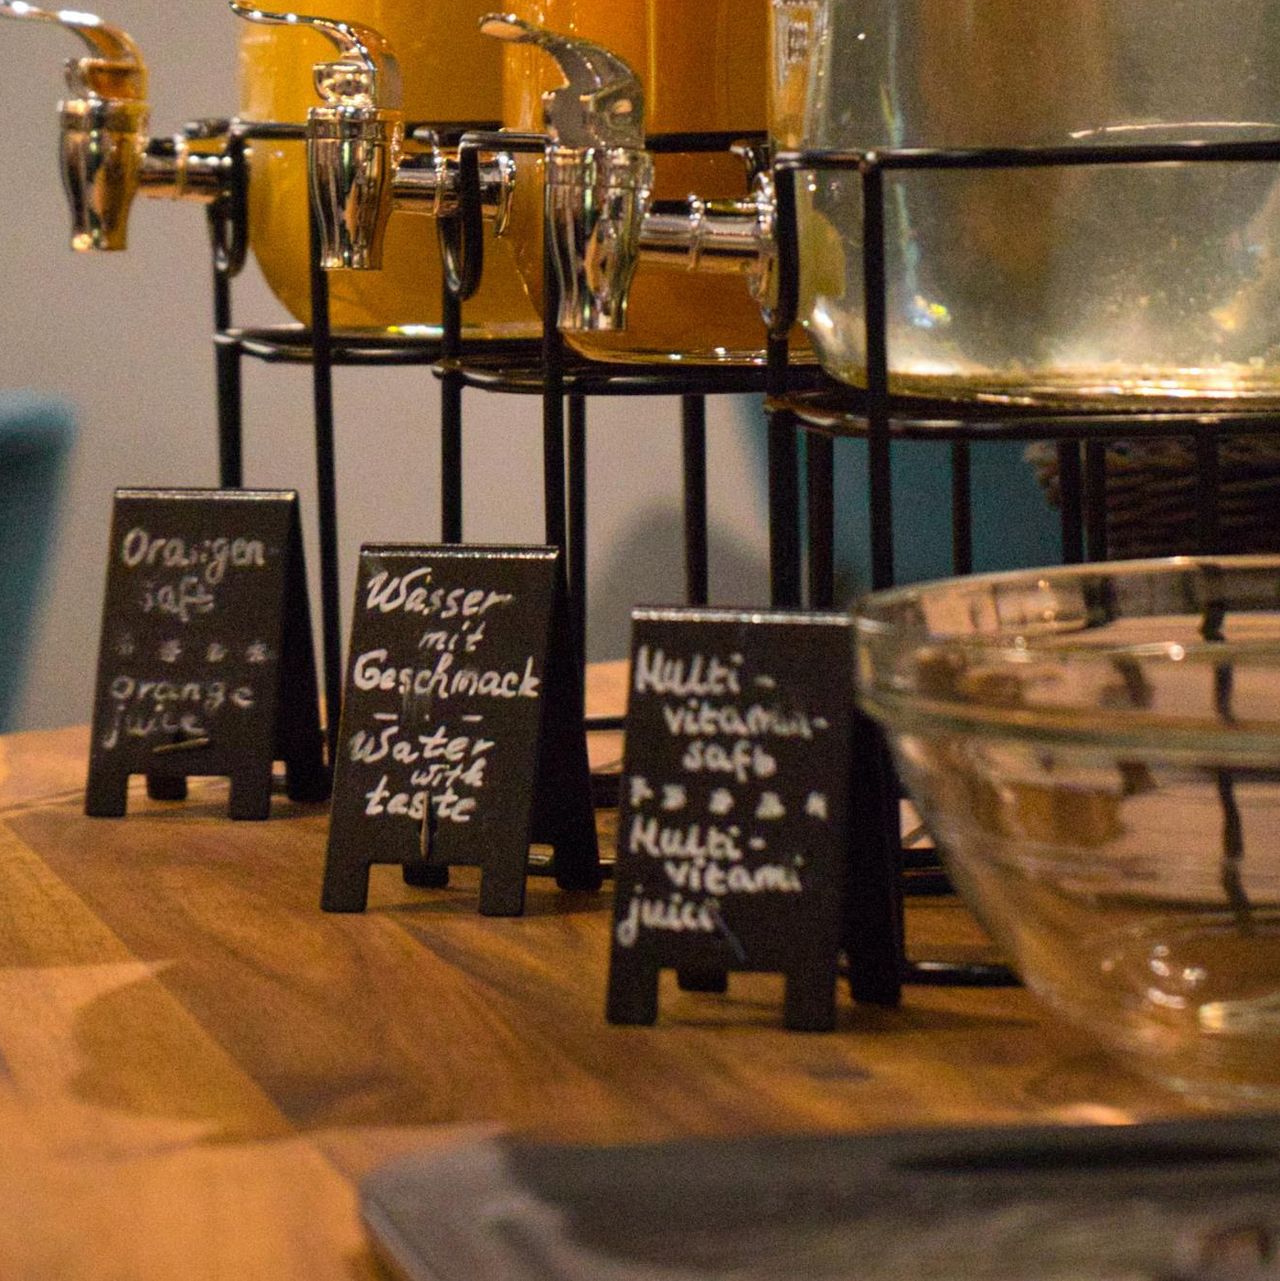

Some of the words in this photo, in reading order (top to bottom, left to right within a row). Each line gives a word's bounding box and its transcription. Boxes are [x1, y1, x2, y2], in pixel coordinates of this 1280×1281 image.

[366, 566, 513, 619] Wasser
[418, 620, 487, 652] mit
[353, 648, 541, 700] Geschmack
[349, 725, 495, 764] Water
[410, 757, 488, 788] with
[365, 775, 477, 823] taste
